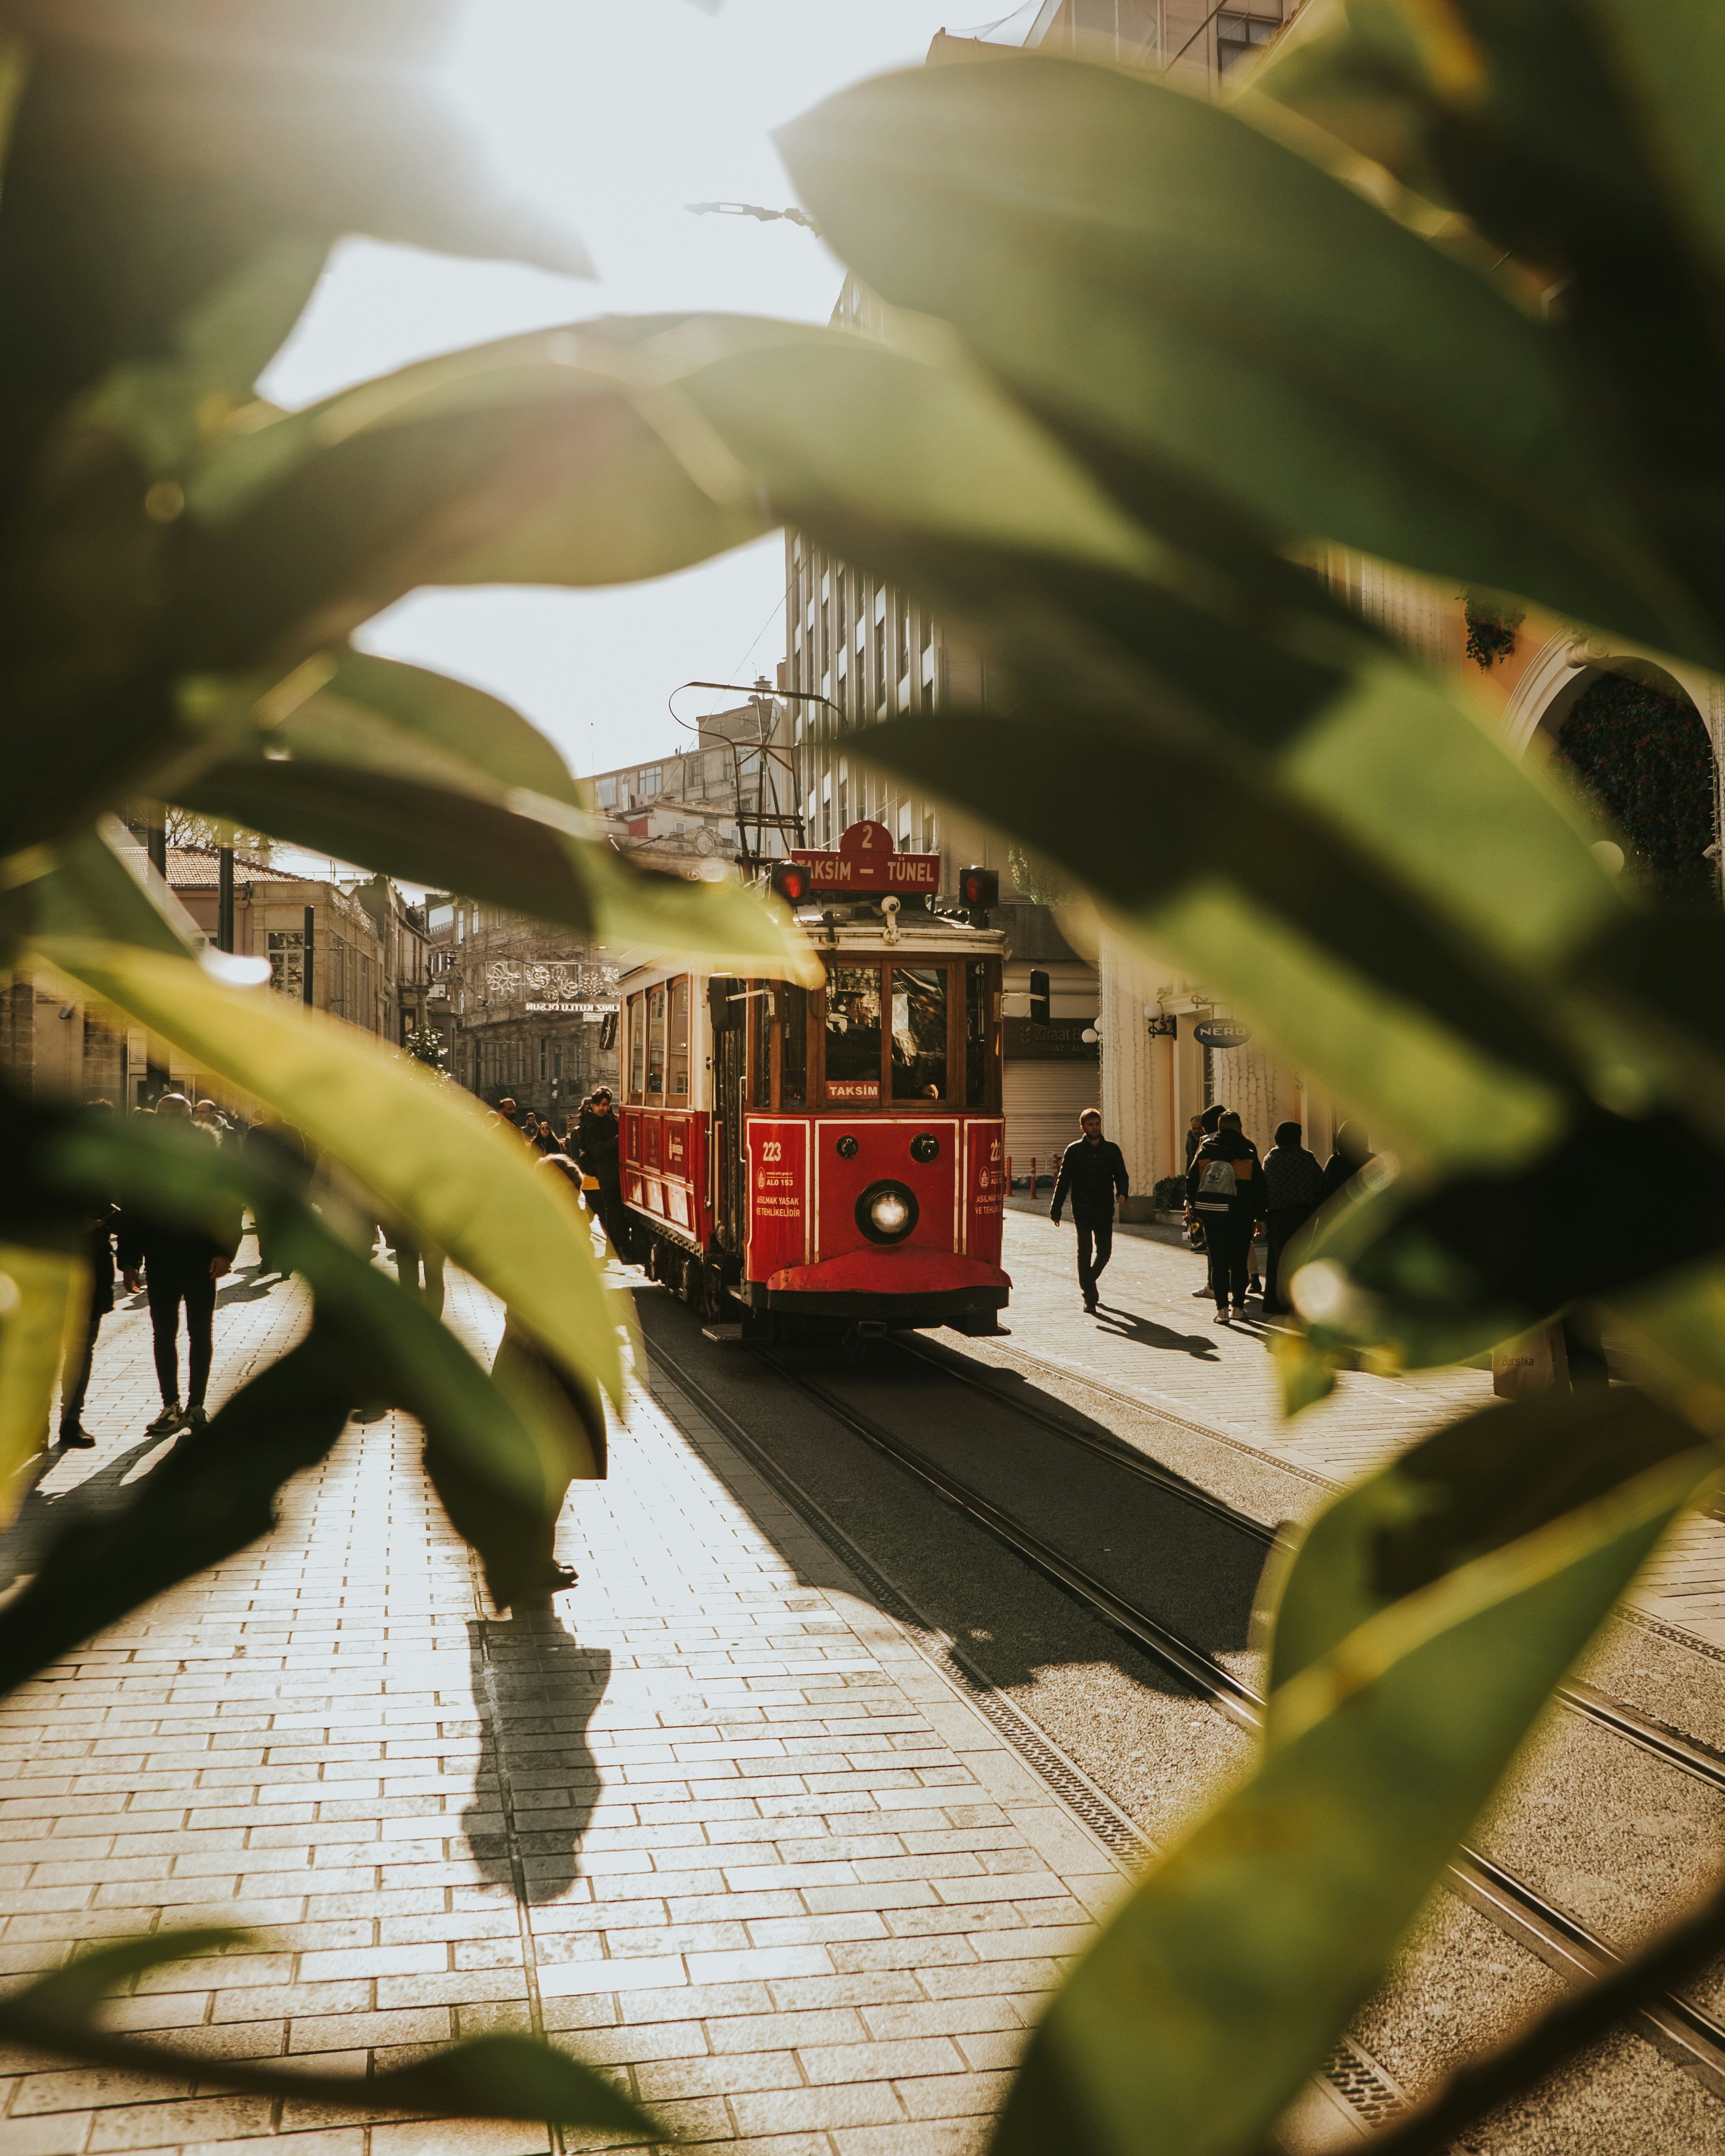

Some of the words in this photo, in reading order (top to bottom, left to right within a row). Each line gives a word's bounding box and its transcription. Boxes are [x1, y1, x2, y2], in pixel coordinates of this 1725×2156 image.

[862, 825, 873, 849] 2
[887, 857, 934, 882] TÜNEL
[1034, 1028, 1071, 1041] Ziraat
[1200, 1028, 1246, 1036] NERO
[829, 1083, 878, 1096] TAKSİM
[763, 1141, 782, 1161] 223
[757, 1196, 777, 1204] ASILMAK
[779, 1197, 800, 1205] YASAK
[761, 1207, 800, 1217] TEHLİKELİDİR
[1501, 1355, 1534, 1366] Bershka
